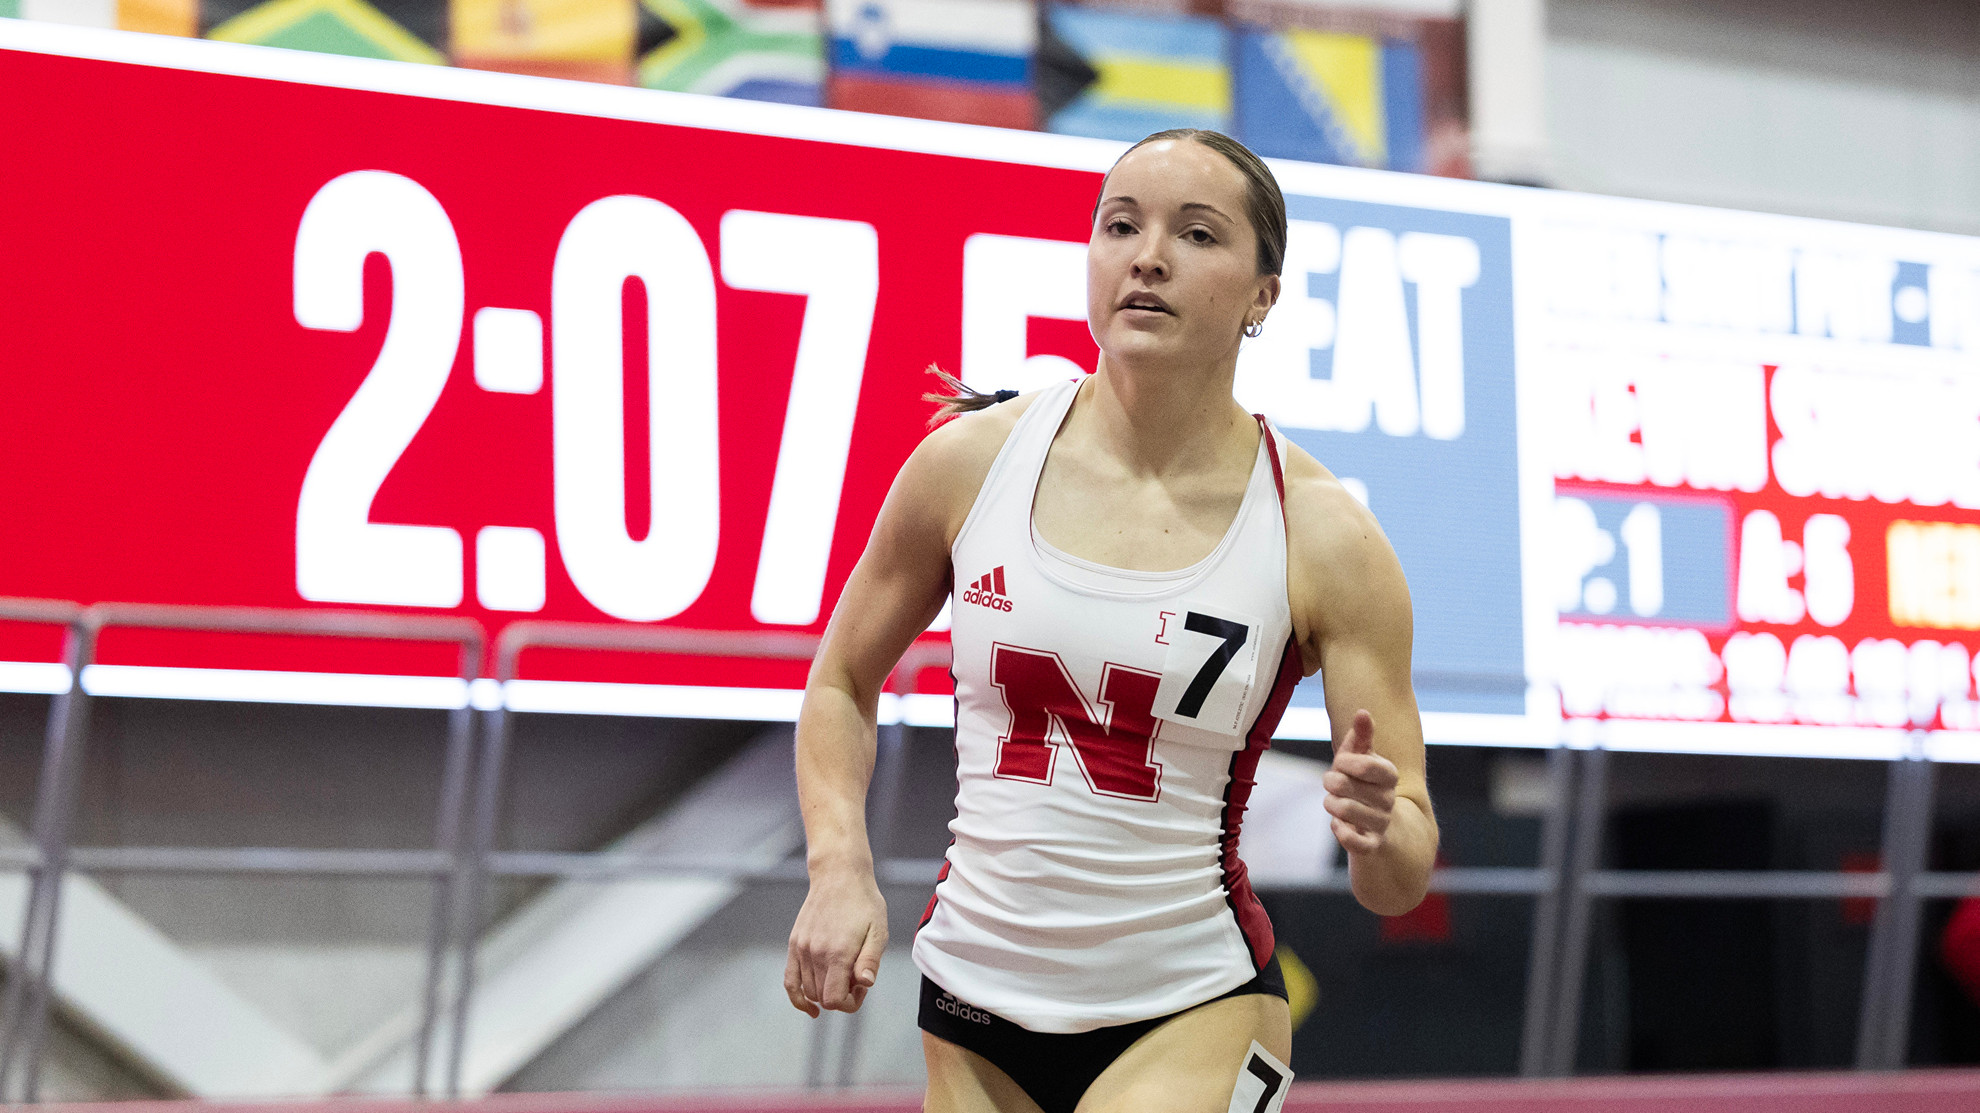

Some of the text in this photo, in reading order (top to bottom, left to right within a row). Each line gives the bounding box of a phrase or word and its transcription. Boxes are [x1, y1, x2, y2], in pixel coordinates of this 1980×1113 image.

[963, 590, 1013, 613] adidas
[1174, 611, 1249, 719] 7
[990, 641, 1162, 803] N
[936, 998, 991, 1025] adidas
[1246, 1052, 1284, 1113] 7
